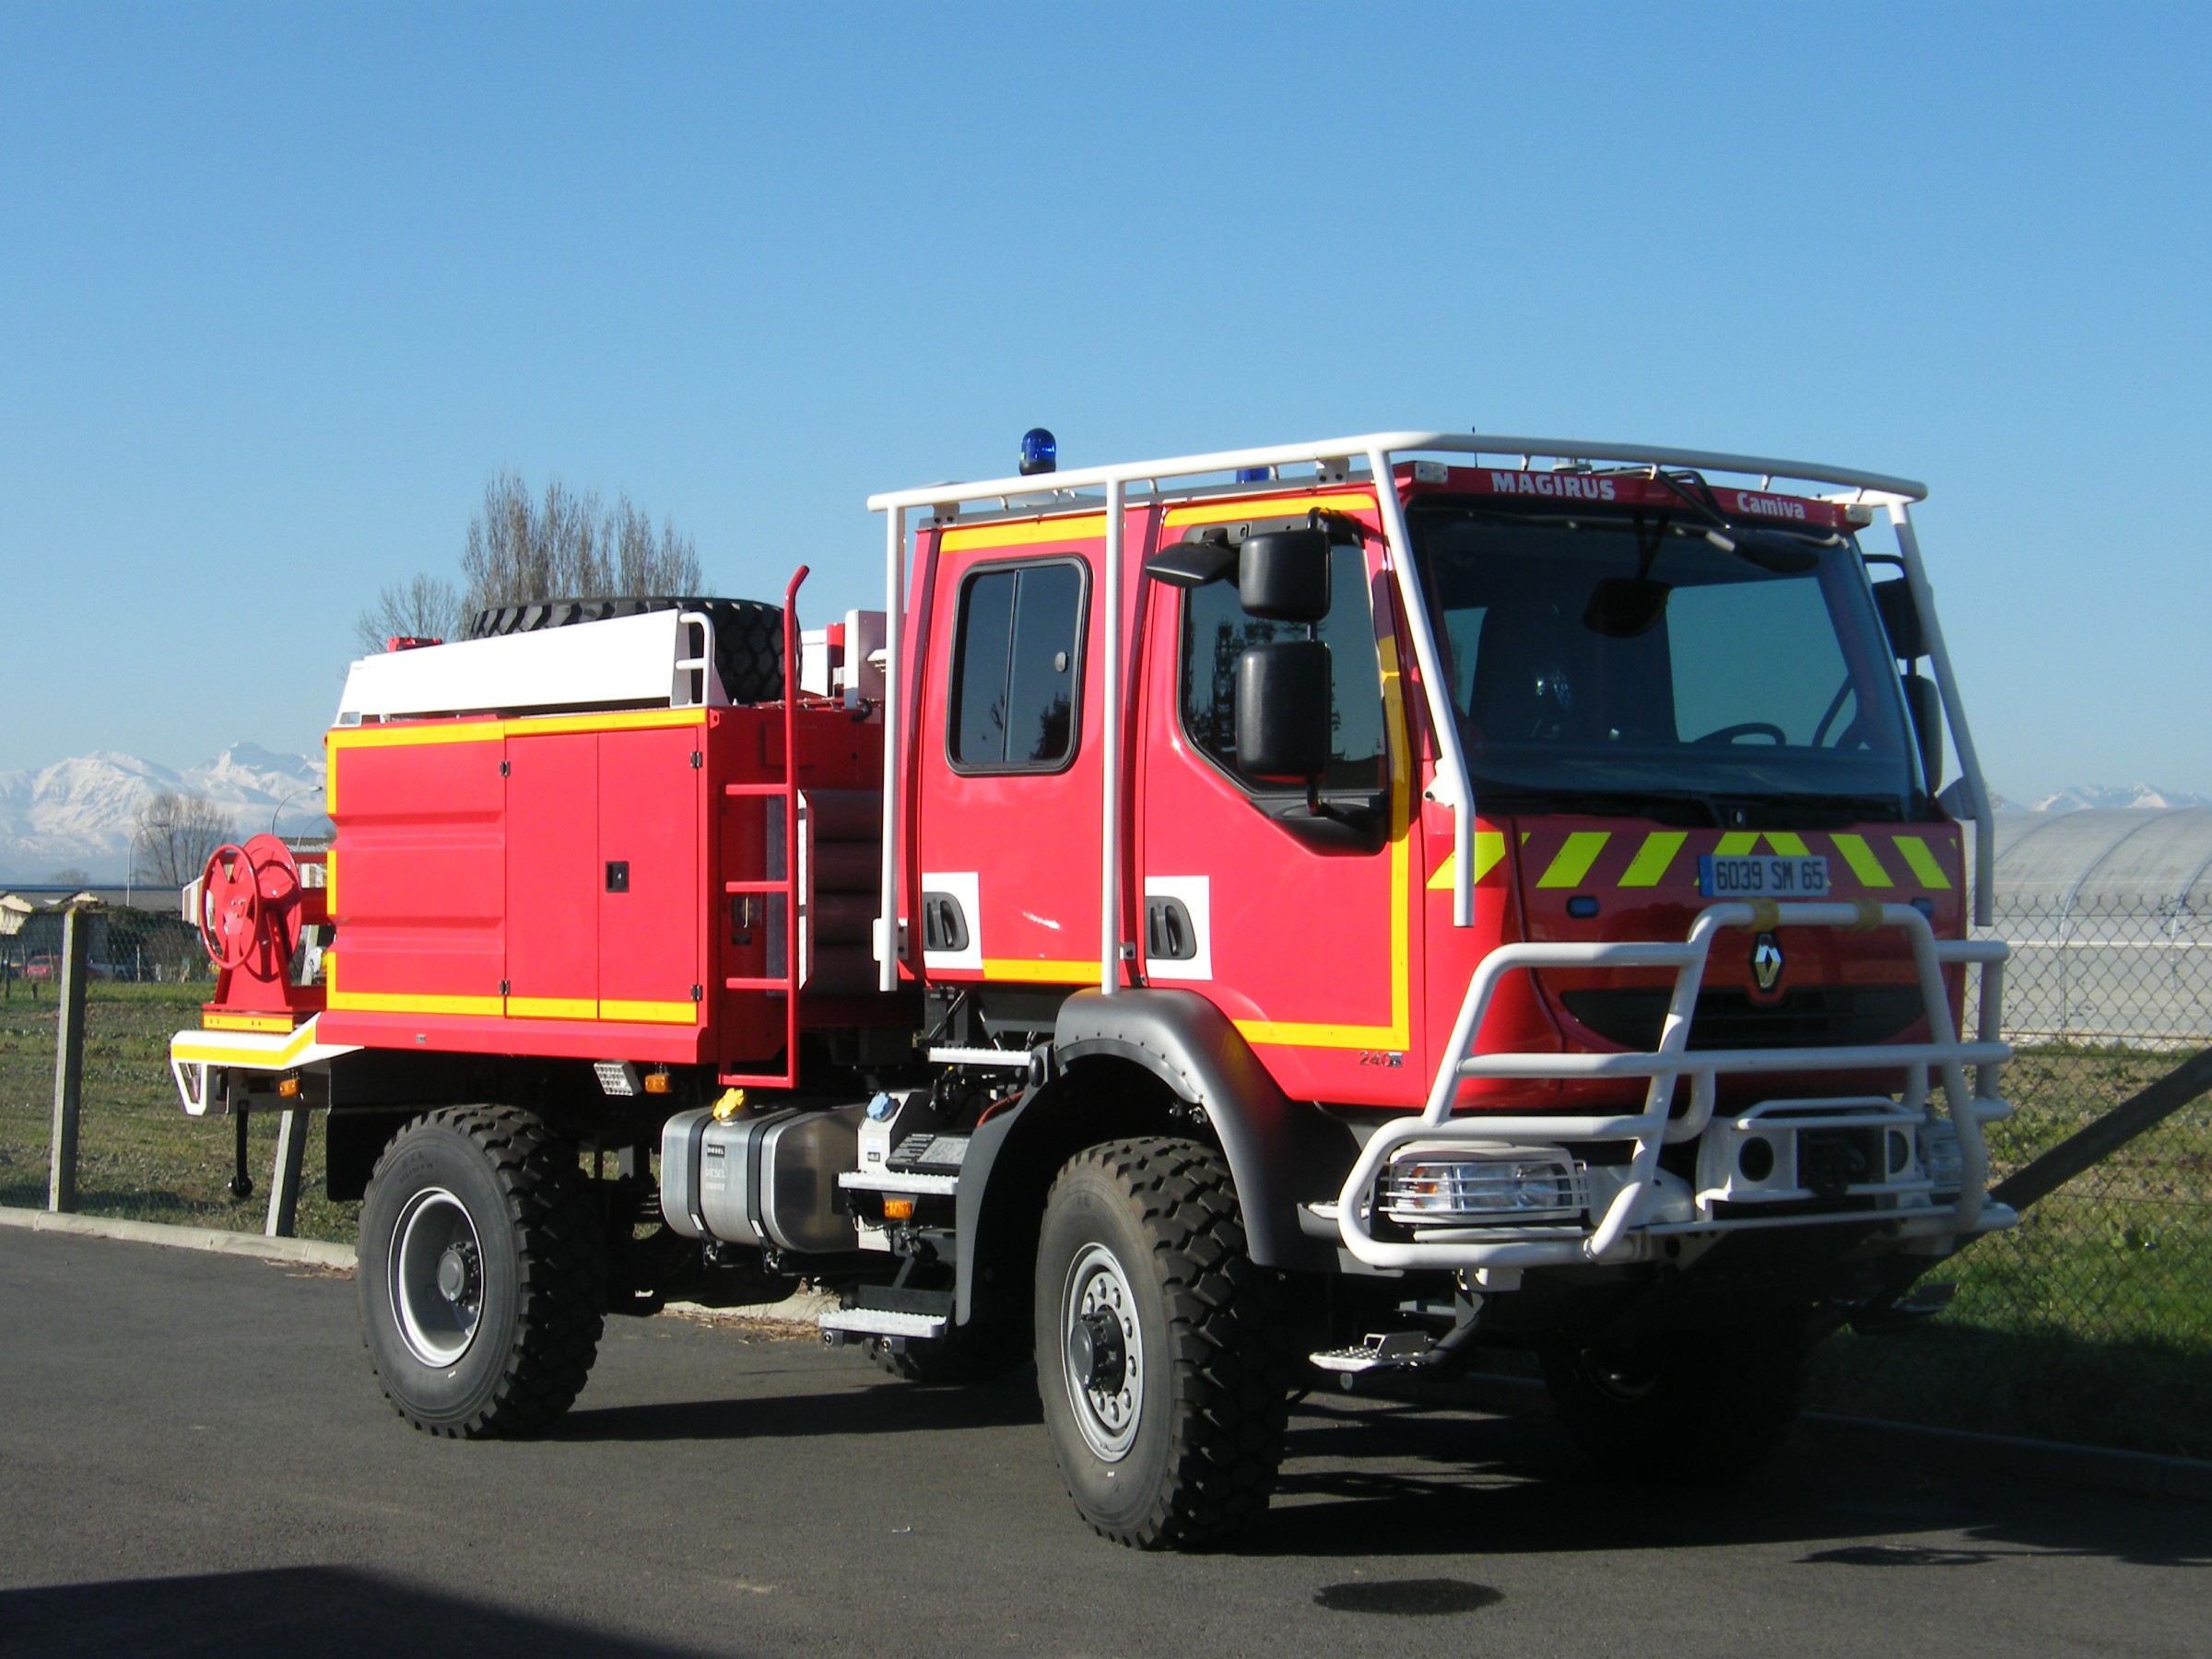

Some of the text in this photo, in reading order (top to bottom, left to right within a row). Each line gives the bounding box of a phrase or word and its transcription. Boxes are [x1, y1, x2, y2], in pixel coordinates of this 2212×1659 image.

[1490, 472, 1616, 500] MAGIRUS
[1736, 491, 1806, 520] Camiva
[1715, 861, 1824, 890] 6039 SM 65
